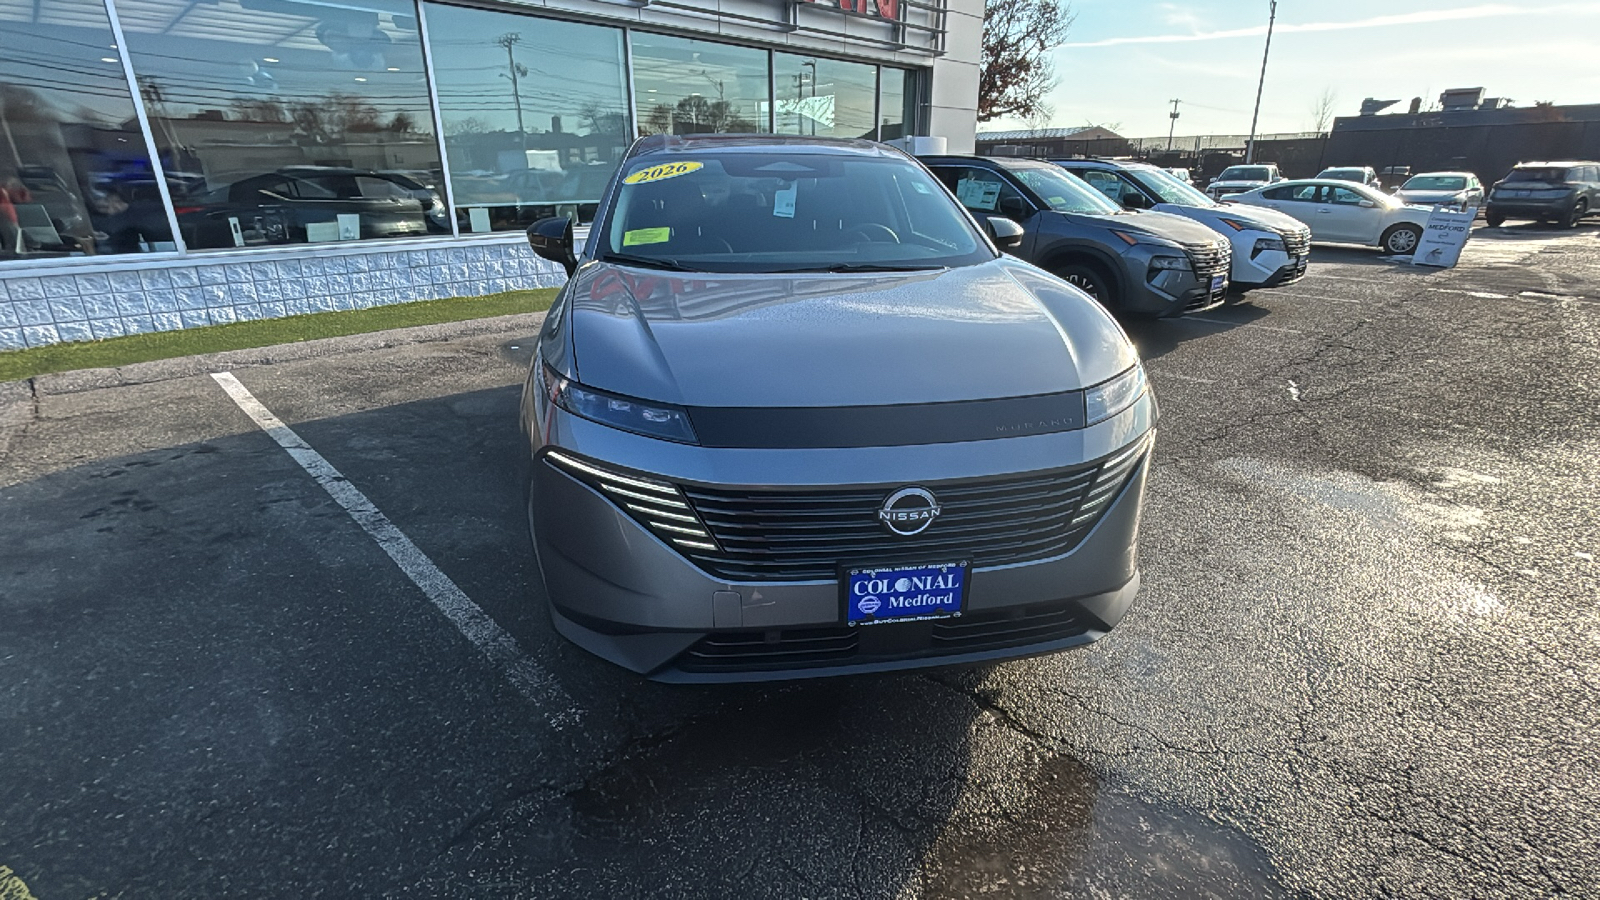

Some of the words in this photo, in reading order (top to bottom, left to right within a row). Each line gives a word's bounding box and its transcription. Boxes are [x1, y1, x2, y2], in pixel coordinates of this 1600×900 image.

[637, 162, 688, 182] 2026
[1427, 224, 1466, 232] MEDFORD
[995, 417, 1073, 432] MURANO
[879, 507, 940, 520] NISSAN
[853, 573, 959, 596] COLONIAL
[888, 592, 953, 609] Medford
